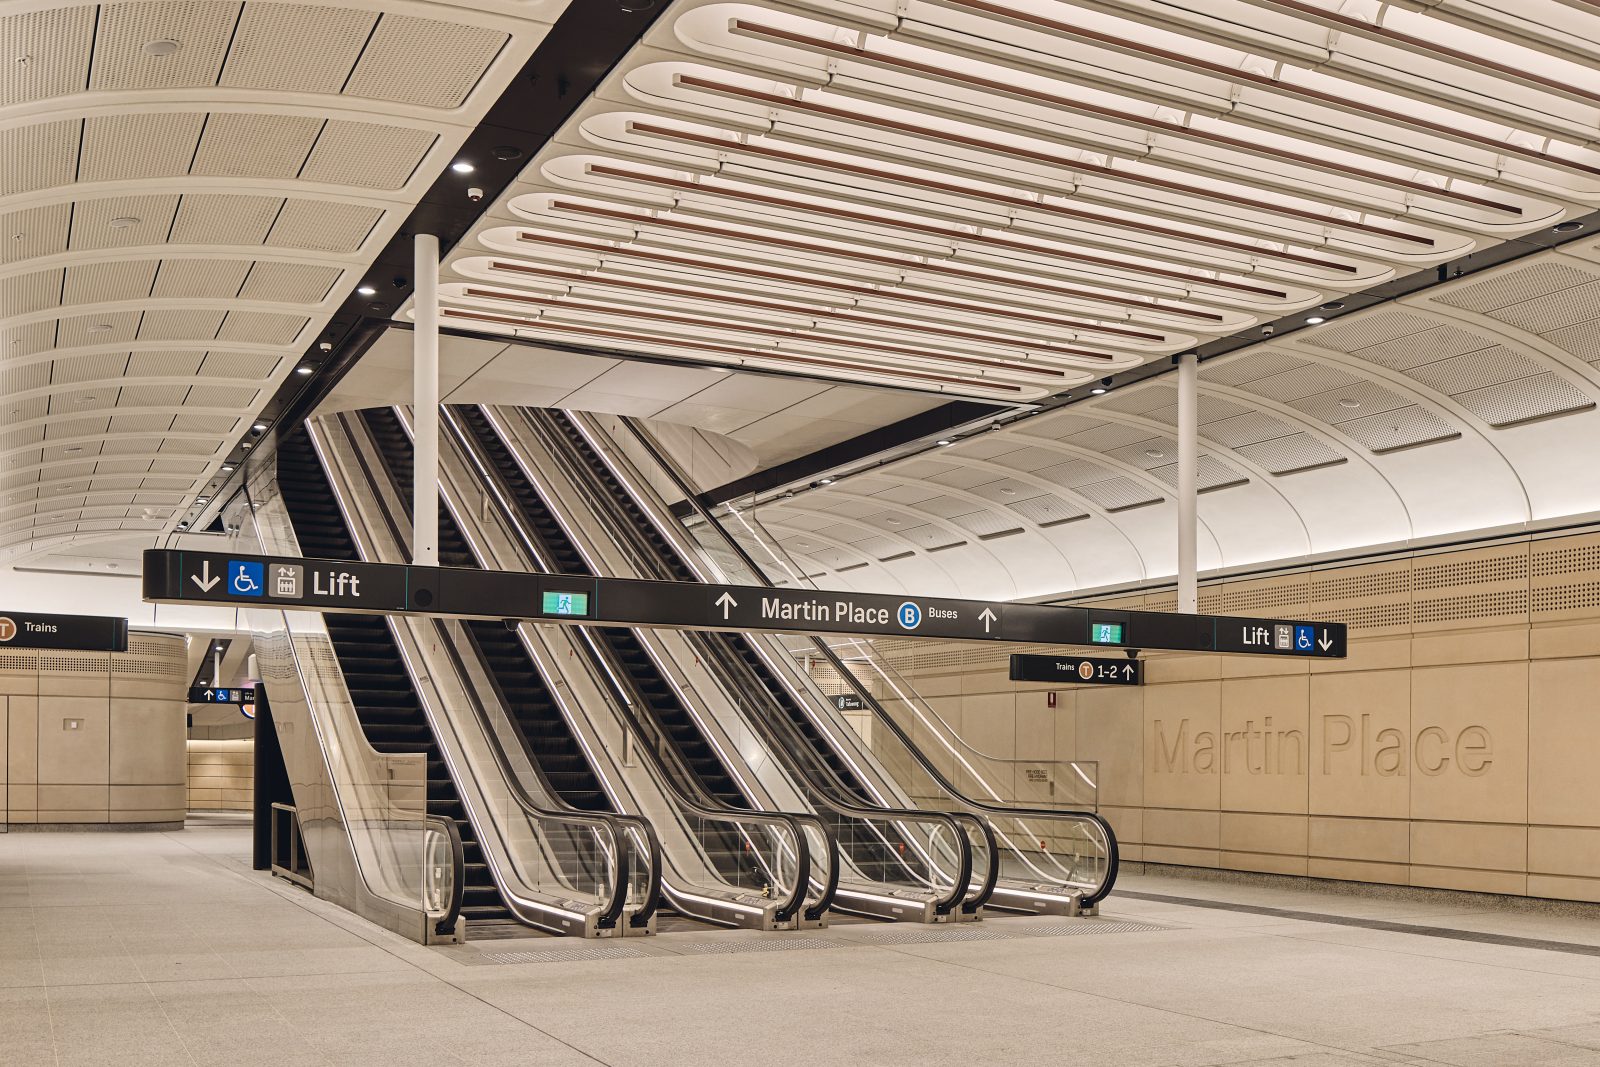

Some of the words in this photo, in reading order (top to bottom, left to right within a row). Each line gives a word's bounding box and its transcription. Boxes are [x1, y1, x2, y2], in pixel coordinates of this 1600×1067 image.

[313, 571, 360, 597] Lift
[761, 597, 829, 621] Martin
[835, 601, 889, 624] Place
[928, 607, 958, 619] Buses
[25, 621, 57, 633] Trains
[1243, 626, 1269, 645] Lift
[1056, 662, 1075, 671] Trains
[1097, 664, 1118, 678] 1-2
[1153, 716, 1305, 775] Martin
[1321, 713, 1493, 777] Place
